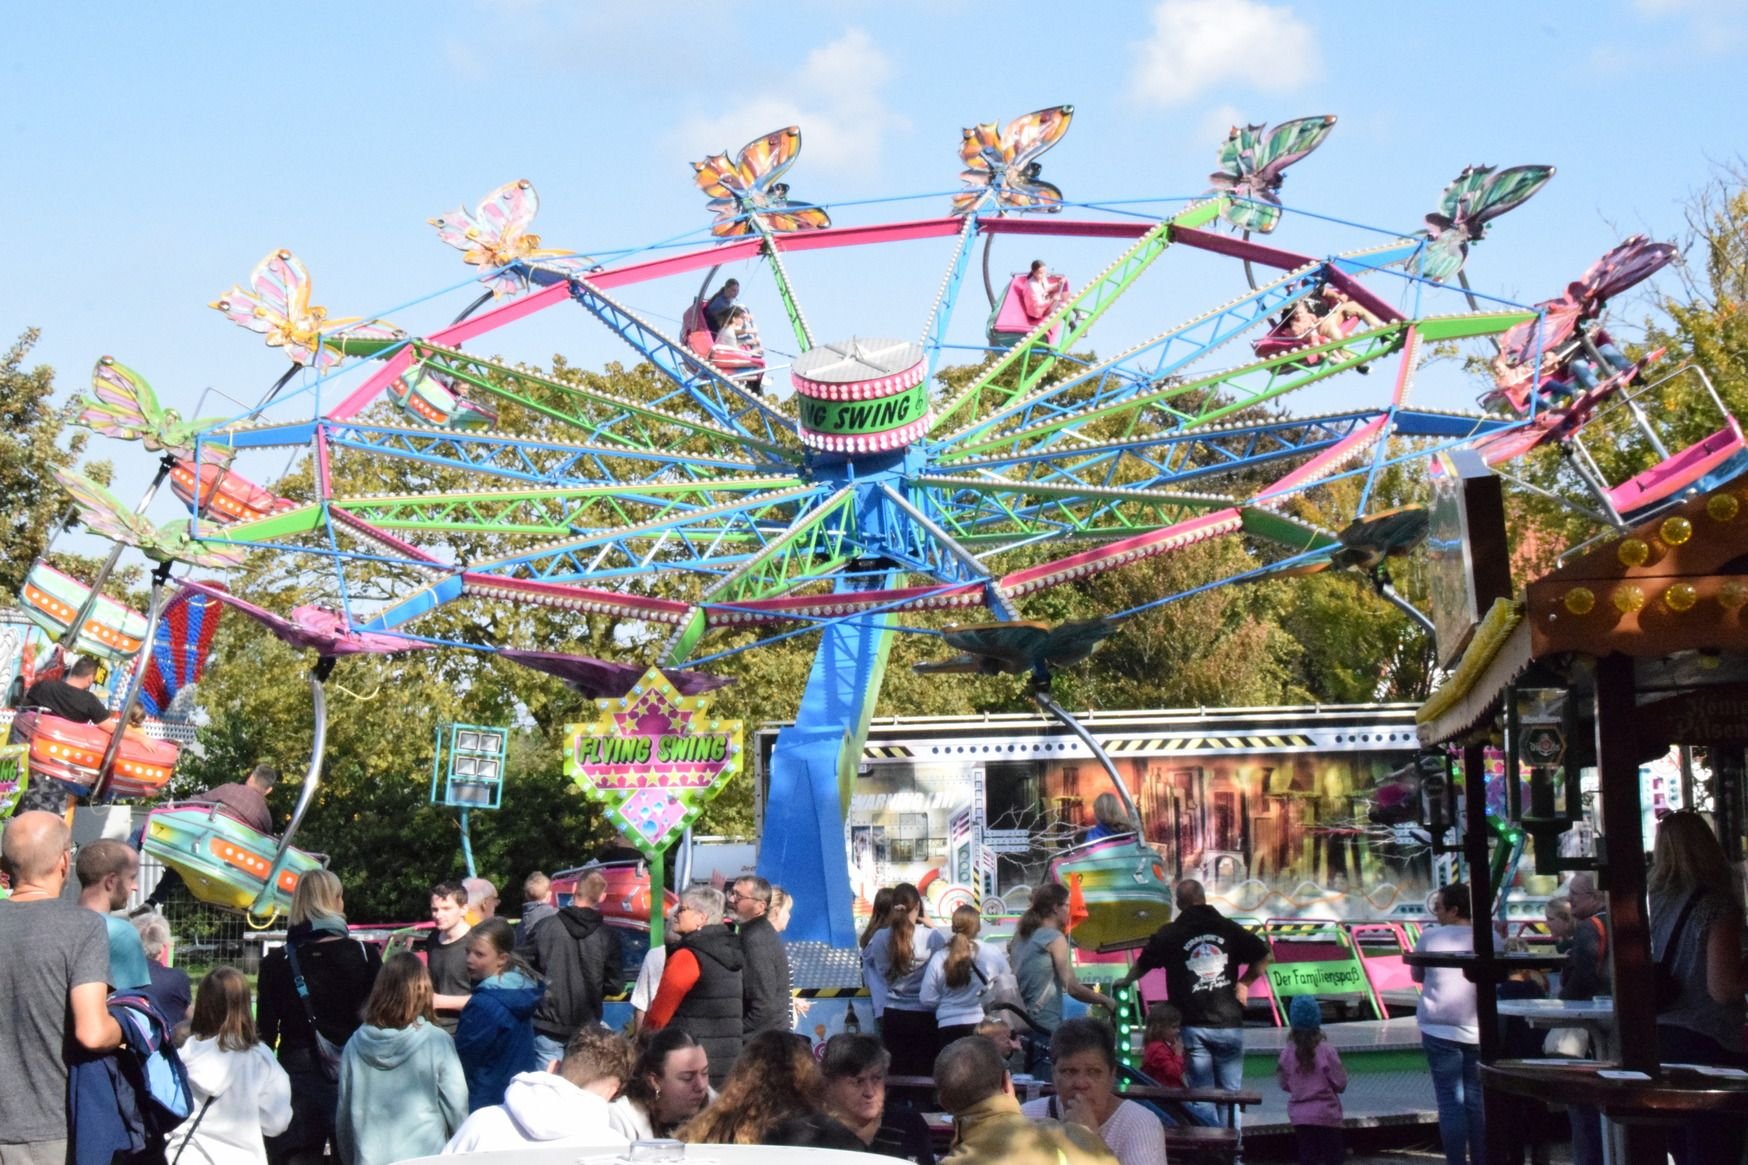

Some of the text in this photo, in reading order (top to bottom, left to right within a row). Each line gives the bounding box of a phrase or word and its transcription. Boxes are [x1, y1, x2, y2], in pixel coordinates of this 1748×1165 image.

[802, 395, 911, 430] NG SWING
[577, 734, 728, 765] FLYING SWING
[0, 758, 19, 783] NG
[1272, 966, 1360, 988] Der Familienspaß
